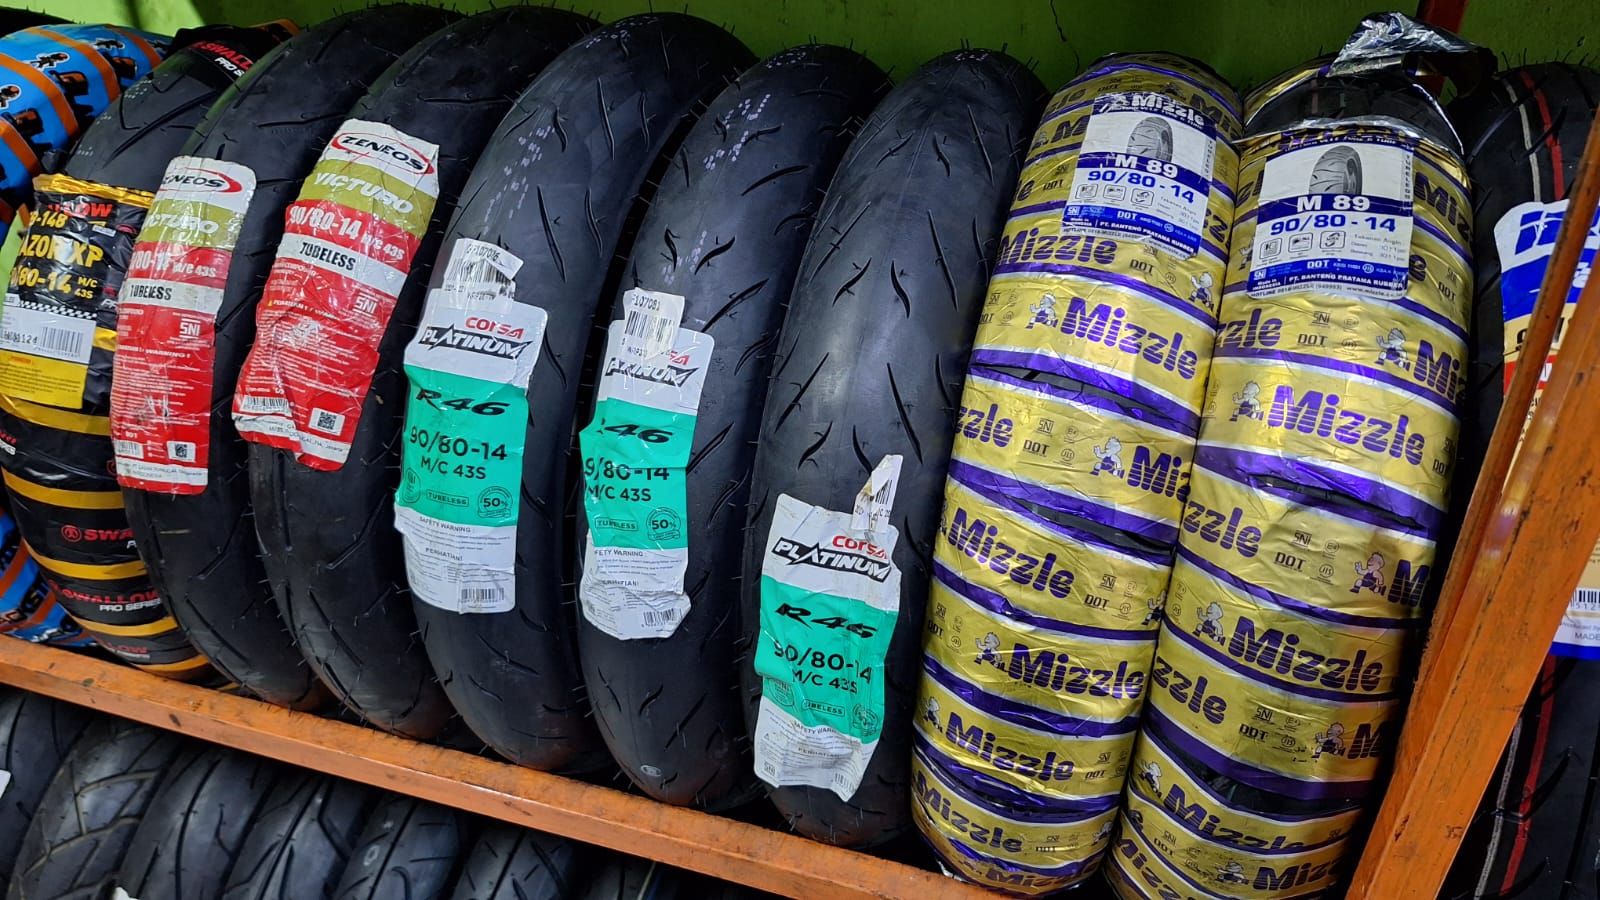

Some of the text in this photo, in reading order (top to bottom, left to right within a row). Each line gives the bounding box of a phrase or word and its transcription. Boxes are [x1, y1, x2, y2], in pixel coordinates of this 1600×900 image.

[1131, 95, 1204, 126] Mizzle
[341, 136, 425, 171] ZENEOS
[1115, 155, 1178, 179] M 89
[314, 172, 414, 214] VICTURO
[1171, 184, 1195, 204] 14
[1296, 195, 1371, 213] M 89
[1117, 210, 1138, 221] DOT
[1365, 216, 1397, 233] 14
[71, 240, 104, 268] XP
[999, 227, 1117, 264] Mizzle
[300, 241, 357, 271] TUBELESS
[1307, 259, 1331, 269] DOT
[1130, 257, 1154, 276] DOT
[77, 276, 98, 288] M/C
[1300, 273, 1336, 281] BANTENG
[1337, 274, 1372, 285] PRATAMA
[74, 288, 94, 300] 43S
[179, 319, 201, 339] SNI
[1060, 296, 1198, 380] Mizzle
[421, 325, 526, 358] PLATINUM
[1297, 332, 1328, 347] DOT
[1267, 385, 1425, 466] Mizzle
[410, 425, 508, 461] 90/80-14
[1023, 439, 1049, 455] DOT
[420, 456, 487, 480] M/C 43S
[428, 491, 467, 506] TUBELESS
[620, 488, 652, 502] 43S
[440, 522, 472, 534] WARNING
[614, 549, 644, 557] WARNING
[774, 539, 892, 582] PLATINUM
[948, 507, 1075, 600] Mizzle
[1274, 551, 1307, 570] DOT
[100, 604, 123, 612] PRO
[1084, 594, 1110, 611] DOT
[1228, 615, 1384, 692] Mizzle
[1008, 643, 1145, 700] Mizzle
[828, 676, 858, 695] 43S
[1239, 724, 1269, 740] DOT
[945, 712, 1074, 783] Mizzle
[918, 771, 1022, 853] Mizzle
[1164, 783, 1305, 850] Mizzle
